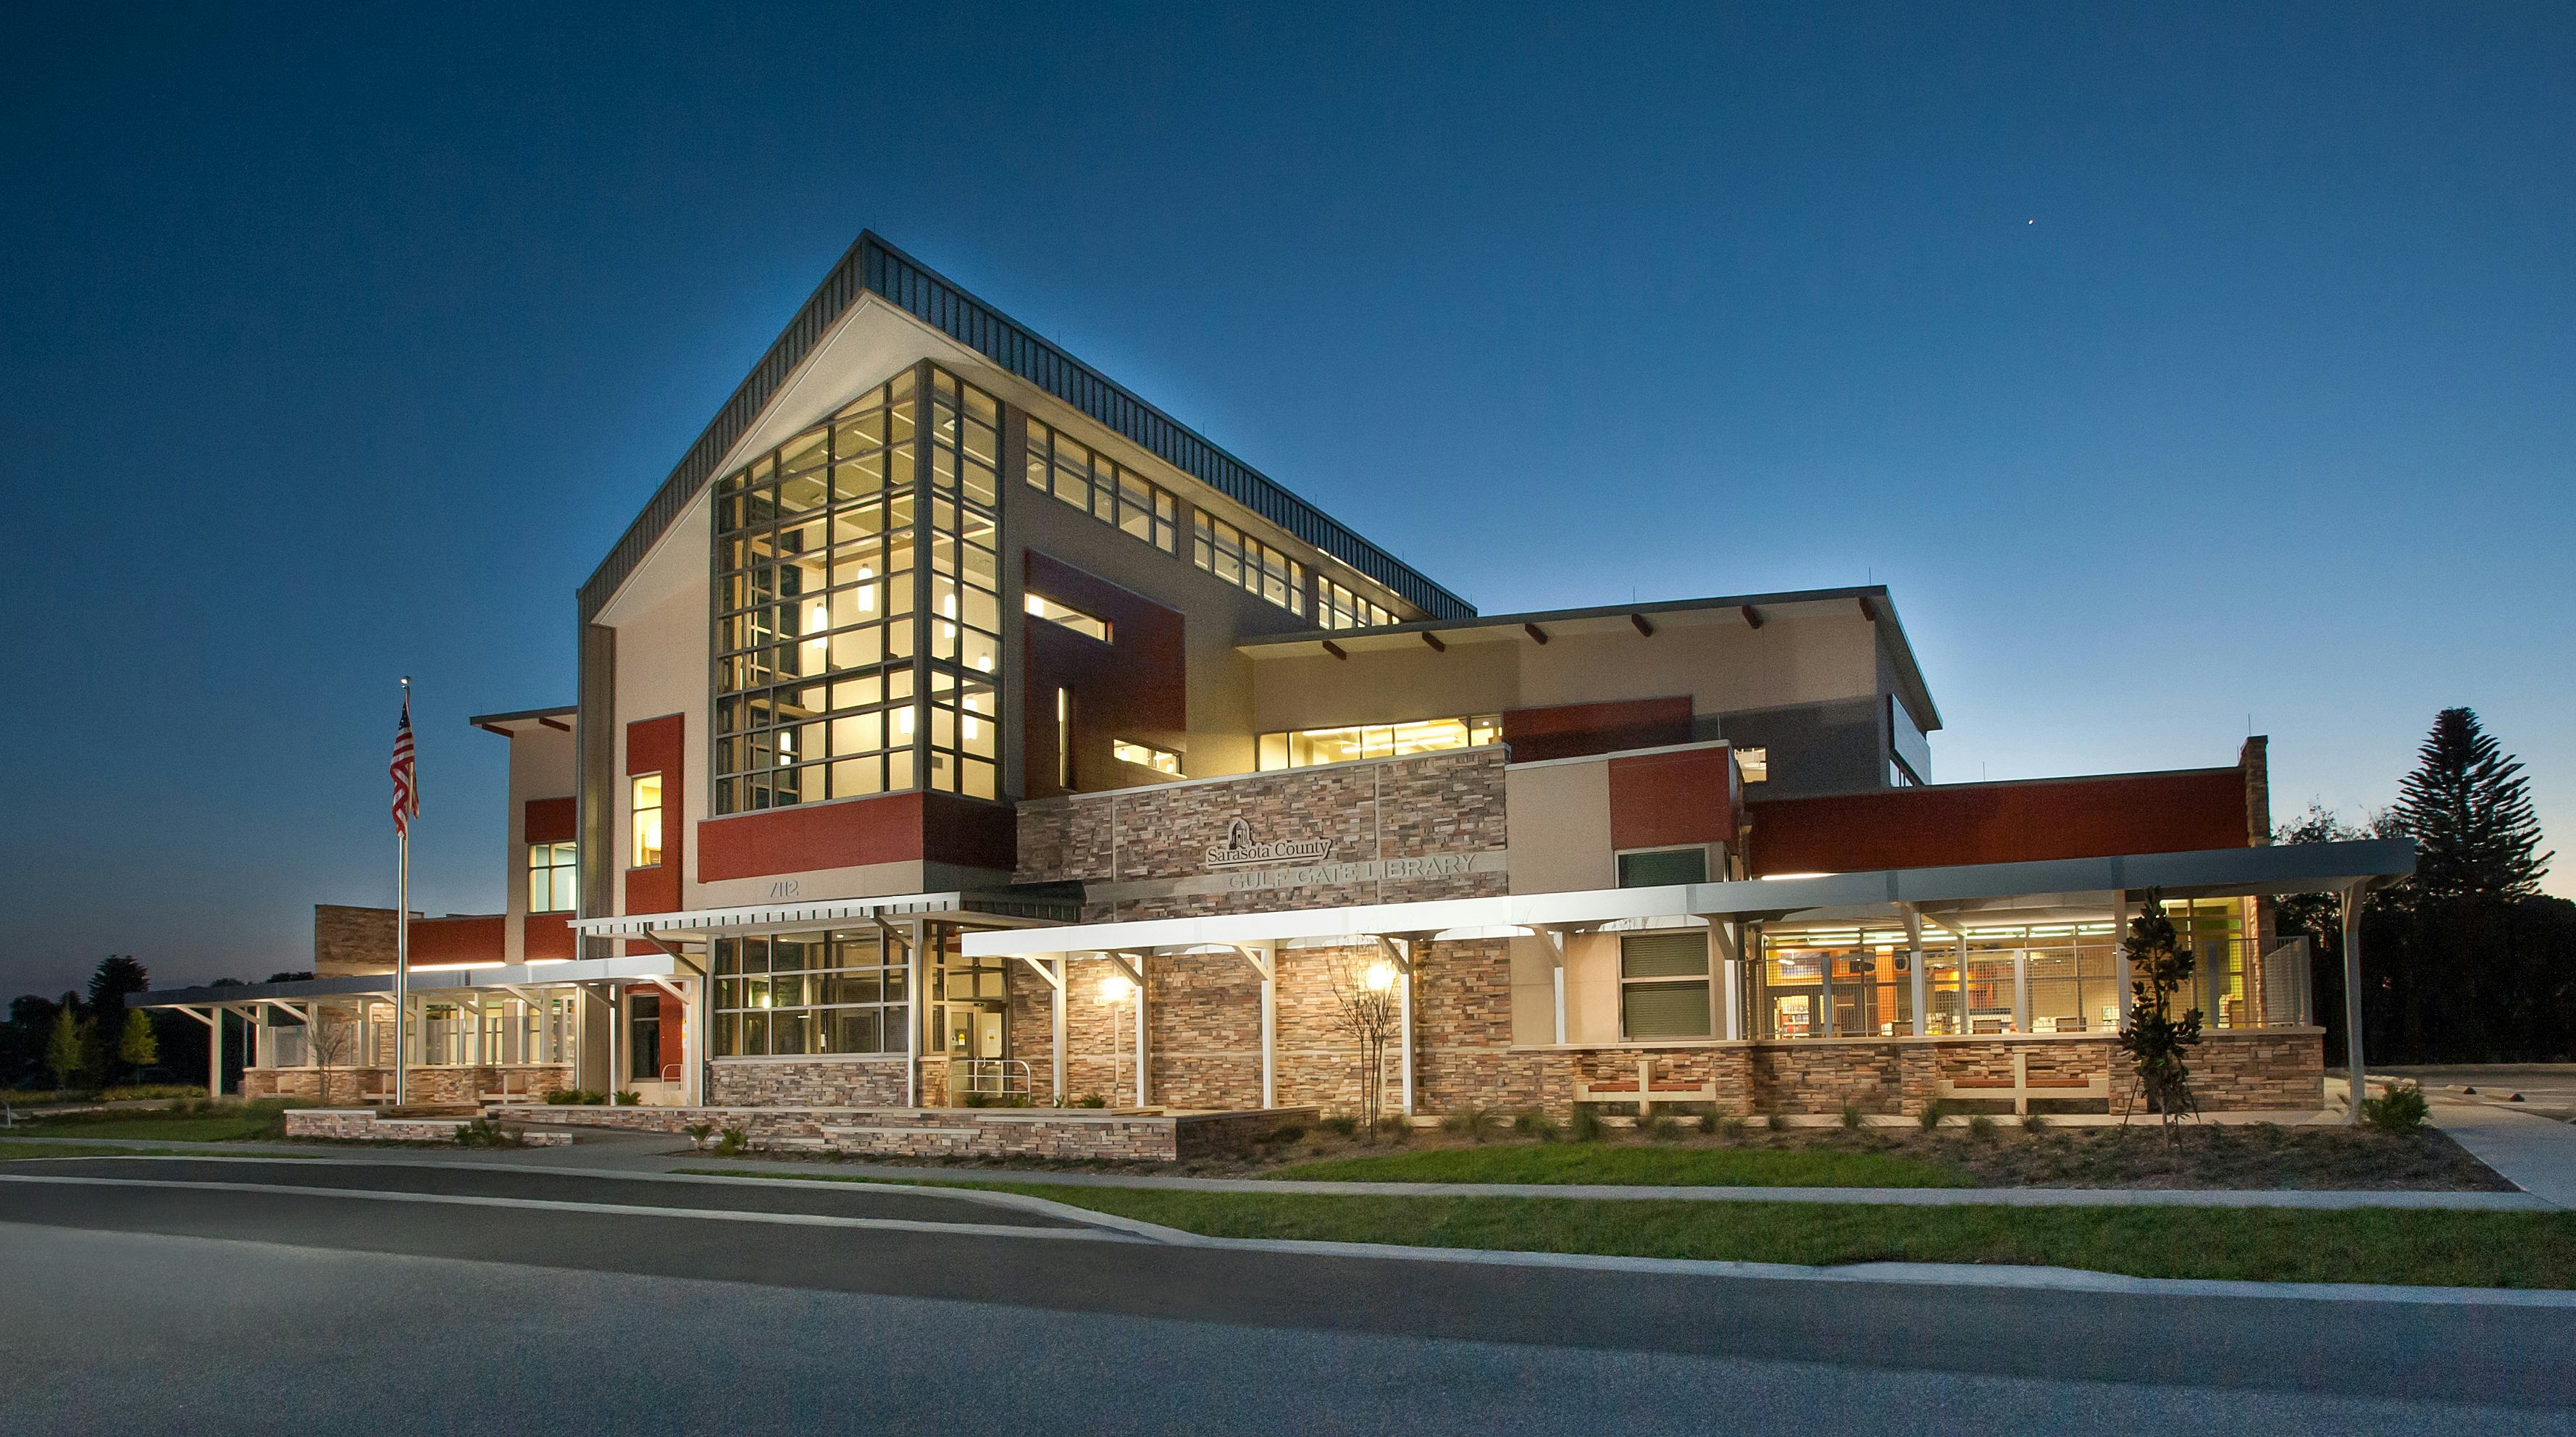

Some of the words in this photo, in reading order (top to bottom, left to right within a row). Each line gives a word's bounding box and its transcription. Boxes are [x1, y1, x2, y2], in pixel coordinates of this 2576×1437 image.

[1208, 847, 1270, 863] Sarasota
[1275, 839, 1329, 856] County
[1229, 869, 1289, 889] GULF
[1297, 863, 1358, 884] GATE
[1366, 854, 1476, 879] LIBRARY
